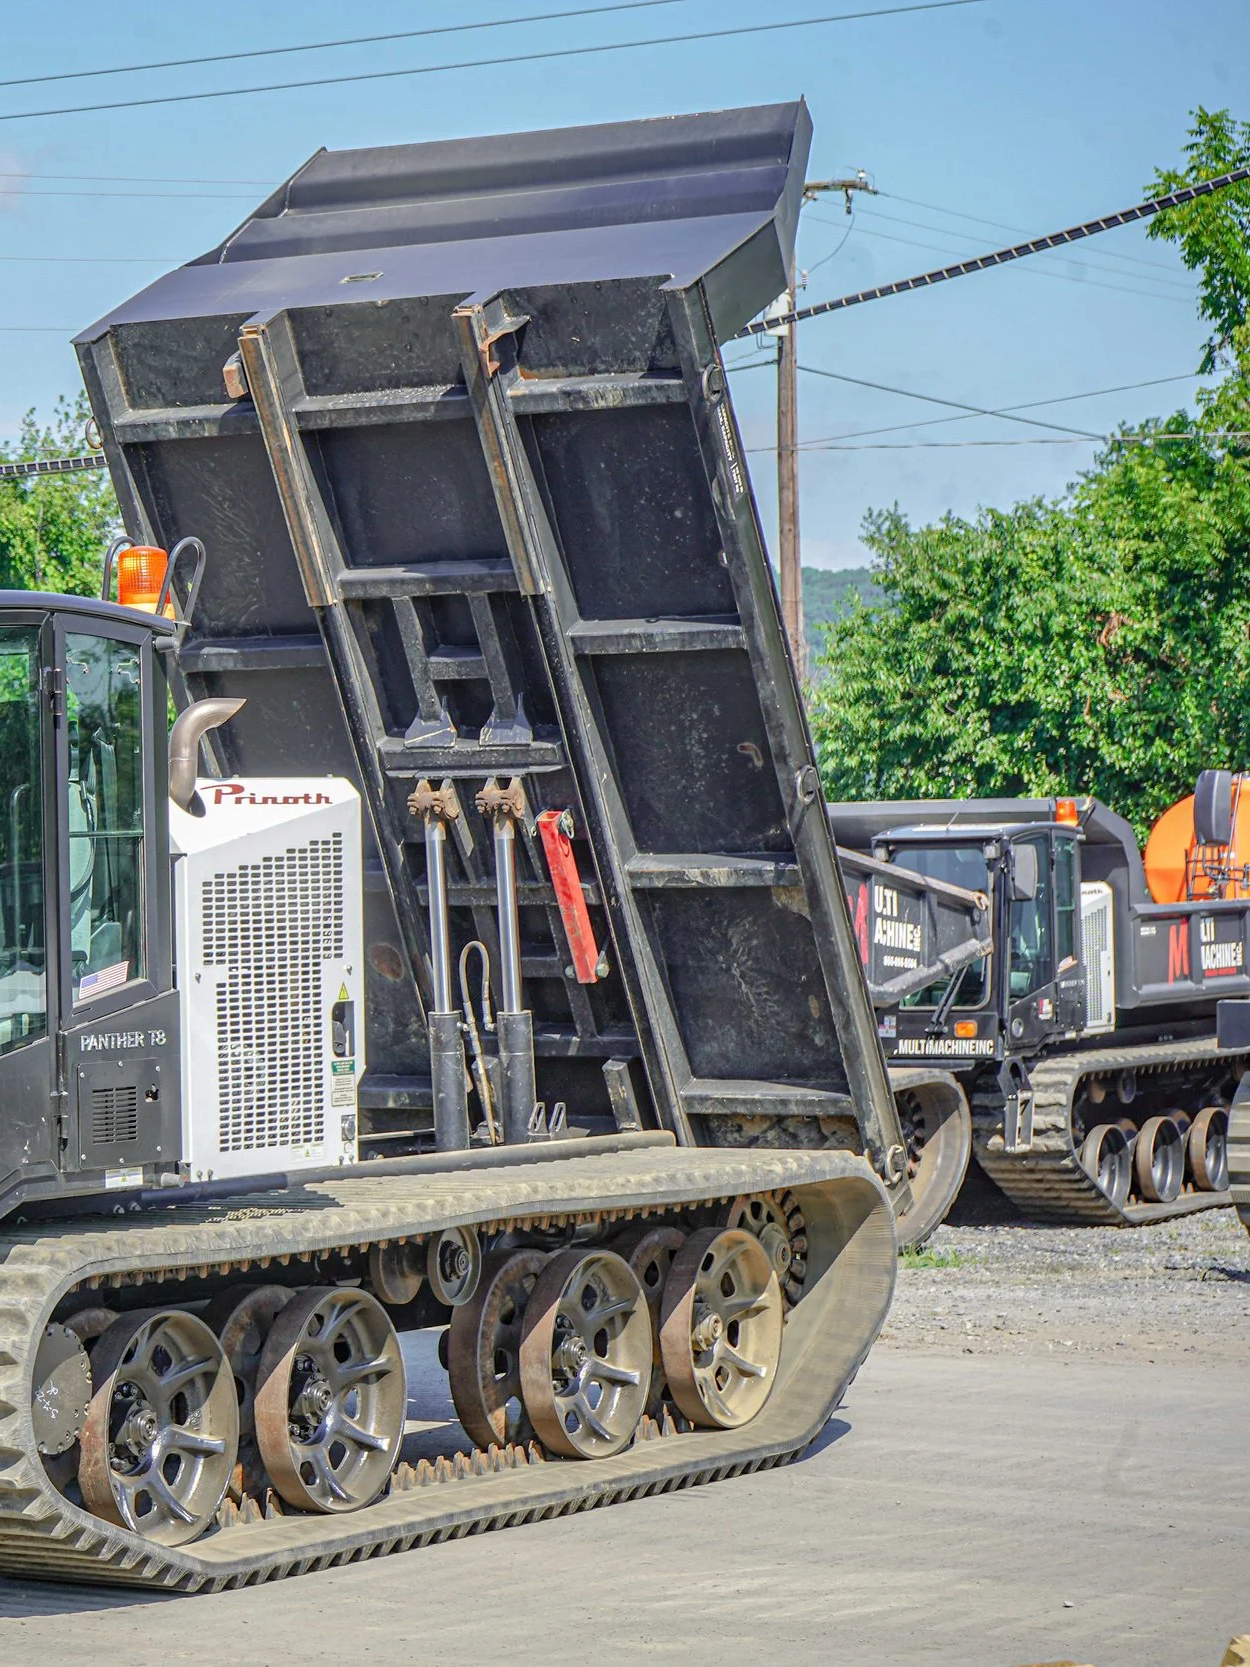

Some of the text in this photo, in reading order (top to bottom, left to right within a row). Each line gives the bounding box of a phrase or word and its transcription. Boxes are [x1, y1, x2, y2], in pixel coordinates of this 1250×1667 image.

[200, 783, 333, 805] Prinoth
[80, 1029, 168, 1052] PANTHER T8
